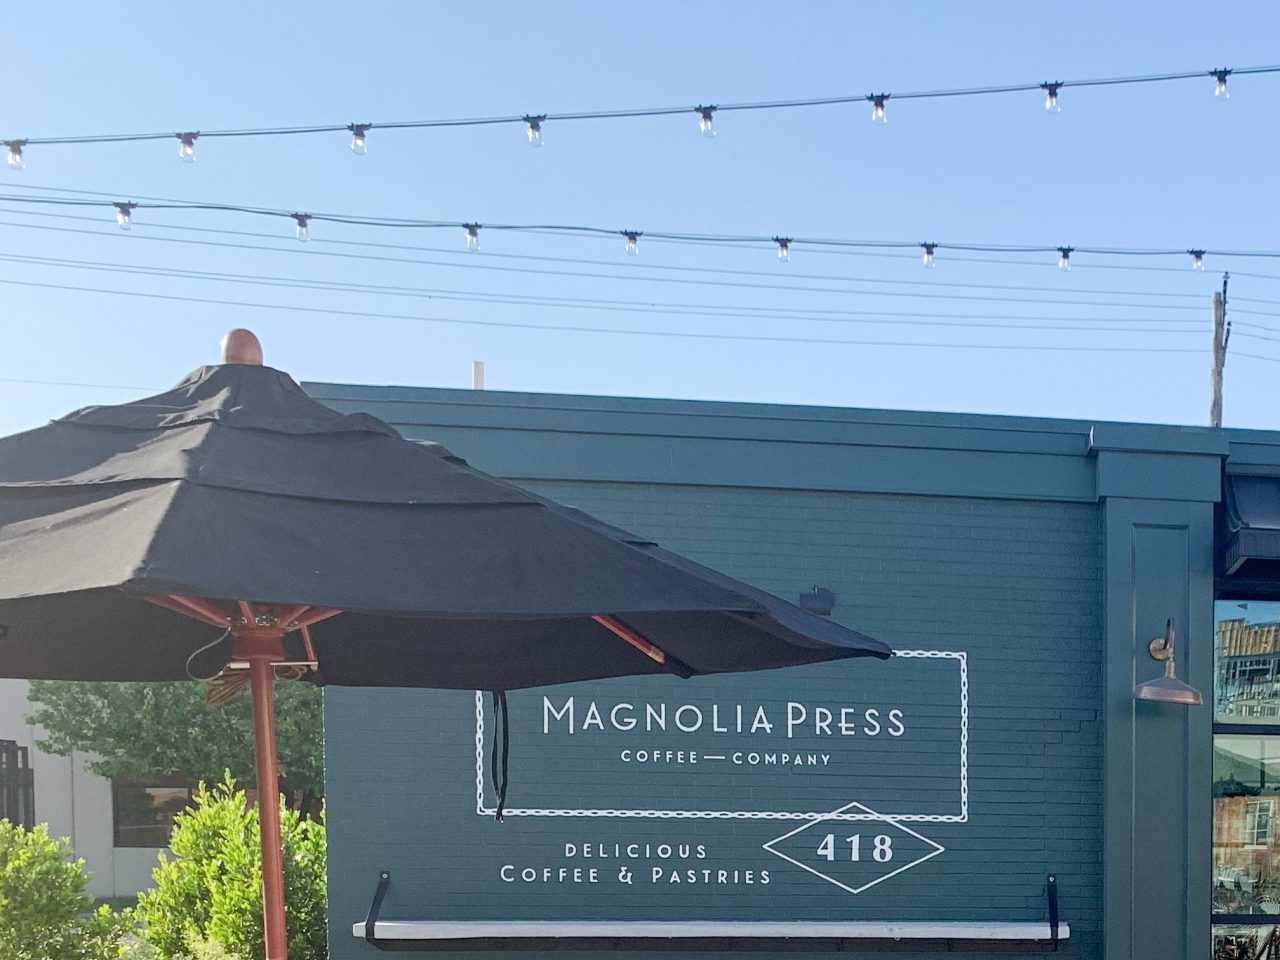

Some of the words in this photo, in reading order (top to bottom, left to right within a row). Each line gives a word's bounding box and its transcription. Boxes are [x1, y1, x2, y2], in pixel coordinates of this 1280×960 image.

[543, 696, 772, 735] MAGNOLIA
[787, 702, 905, 738] PRESS
[620, 749, 698, 765] COFFEE
[732, 751, 831, 767] COMPANY
[565, 843, 706, 859] DELICIOUS
[816, 833, 893, 863] 418
[500, 864, 598, 883] COFFEE
[618, 866, 634, 885] &
[652, 867, 770, 884] PASTRIES
